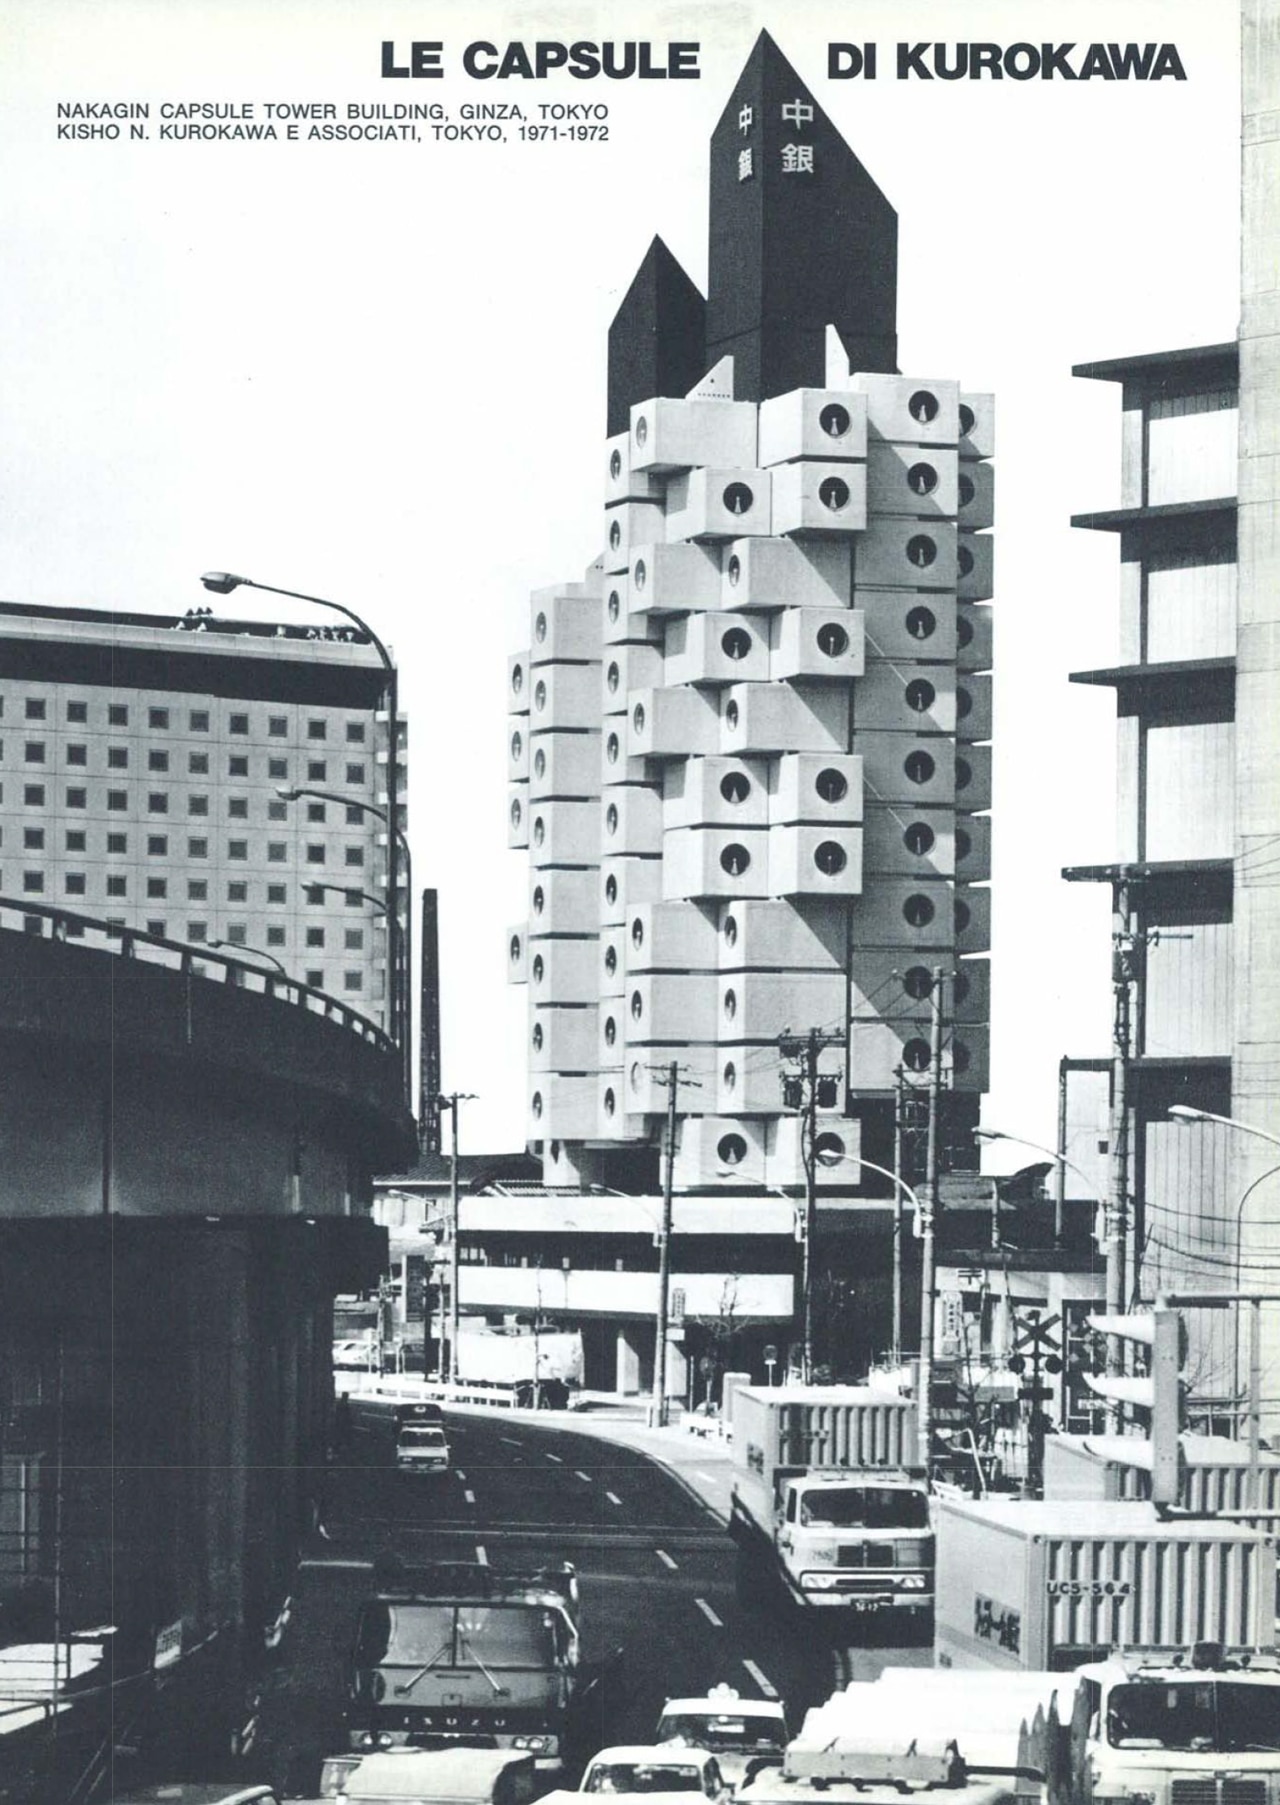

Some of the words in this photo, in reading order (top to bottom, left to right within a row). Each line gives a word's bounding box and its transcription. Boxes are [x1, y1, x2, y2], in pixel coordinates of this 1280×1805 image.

[738, 104, 753, 181] 中銀
[781, 99, 814, 174] 中銀
[404, 1716, 505, 1726] ISUZU
